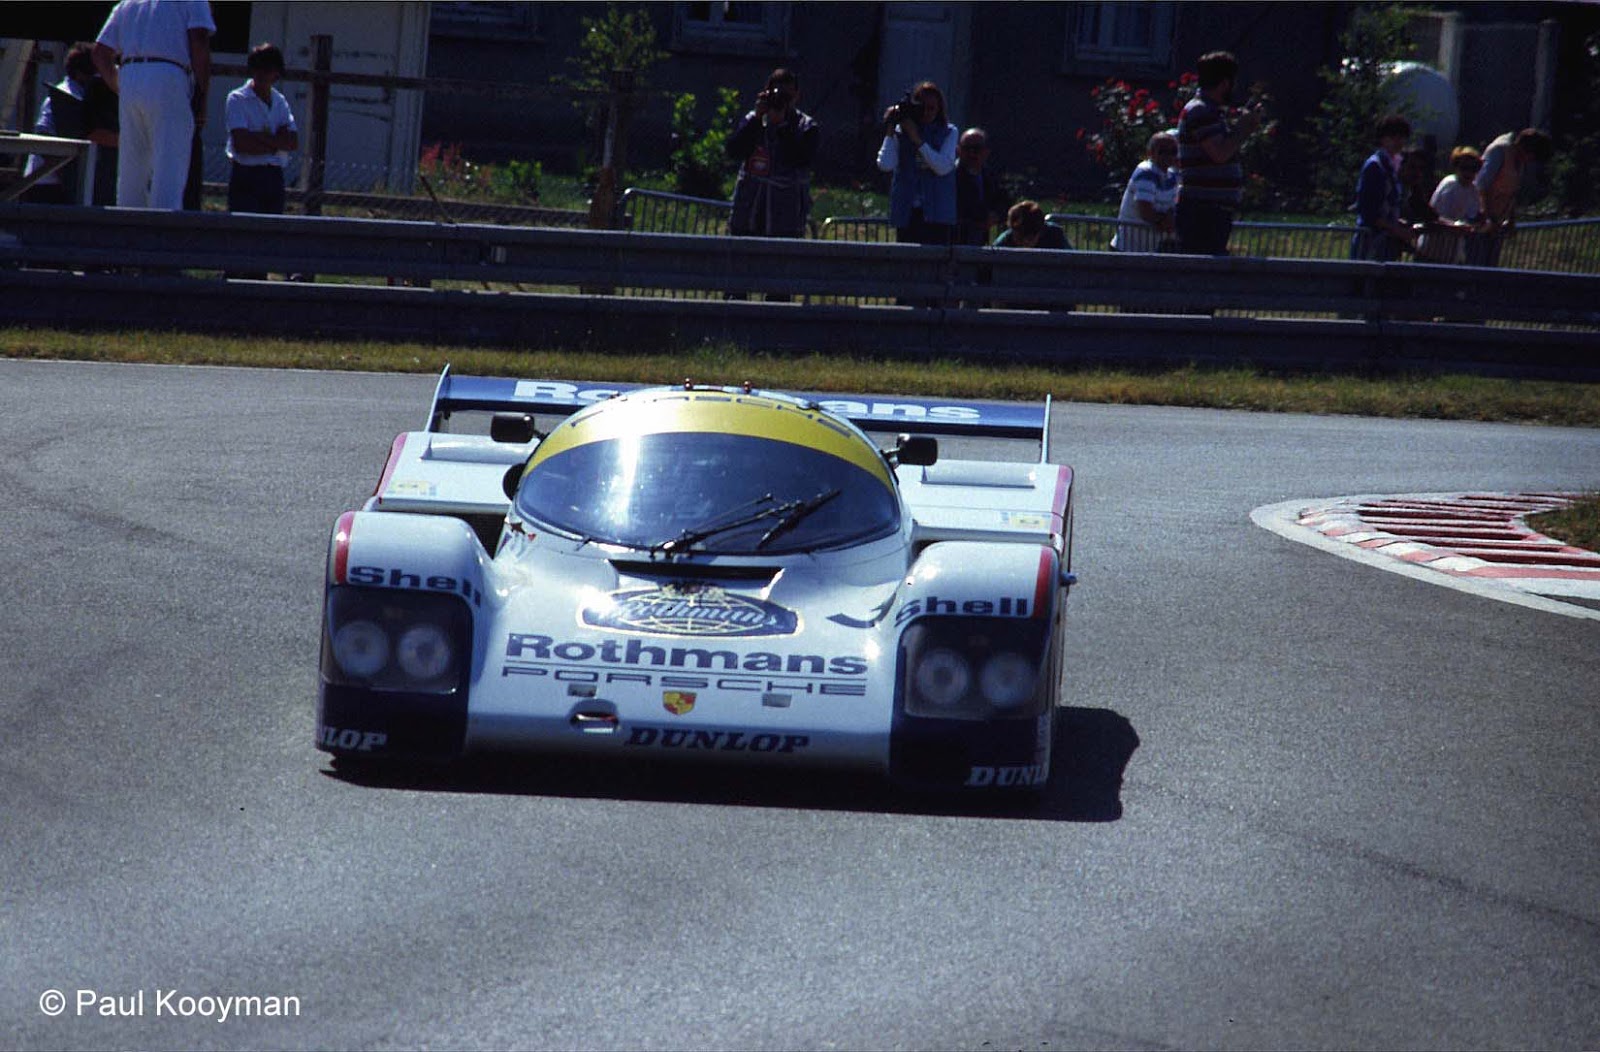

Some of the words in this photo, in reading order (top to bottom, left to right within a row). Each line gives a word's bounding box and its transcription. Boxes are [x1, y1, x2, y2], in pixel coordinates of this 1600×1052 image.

[514, 380, 980, 419] Roans
[895, 596, 1028, 627] Shell
[506, 633, 868, 675] Rothmans
[502, 666, 866, 696] PORSCHE
[625, 726, 809, 754] DUNLOP
